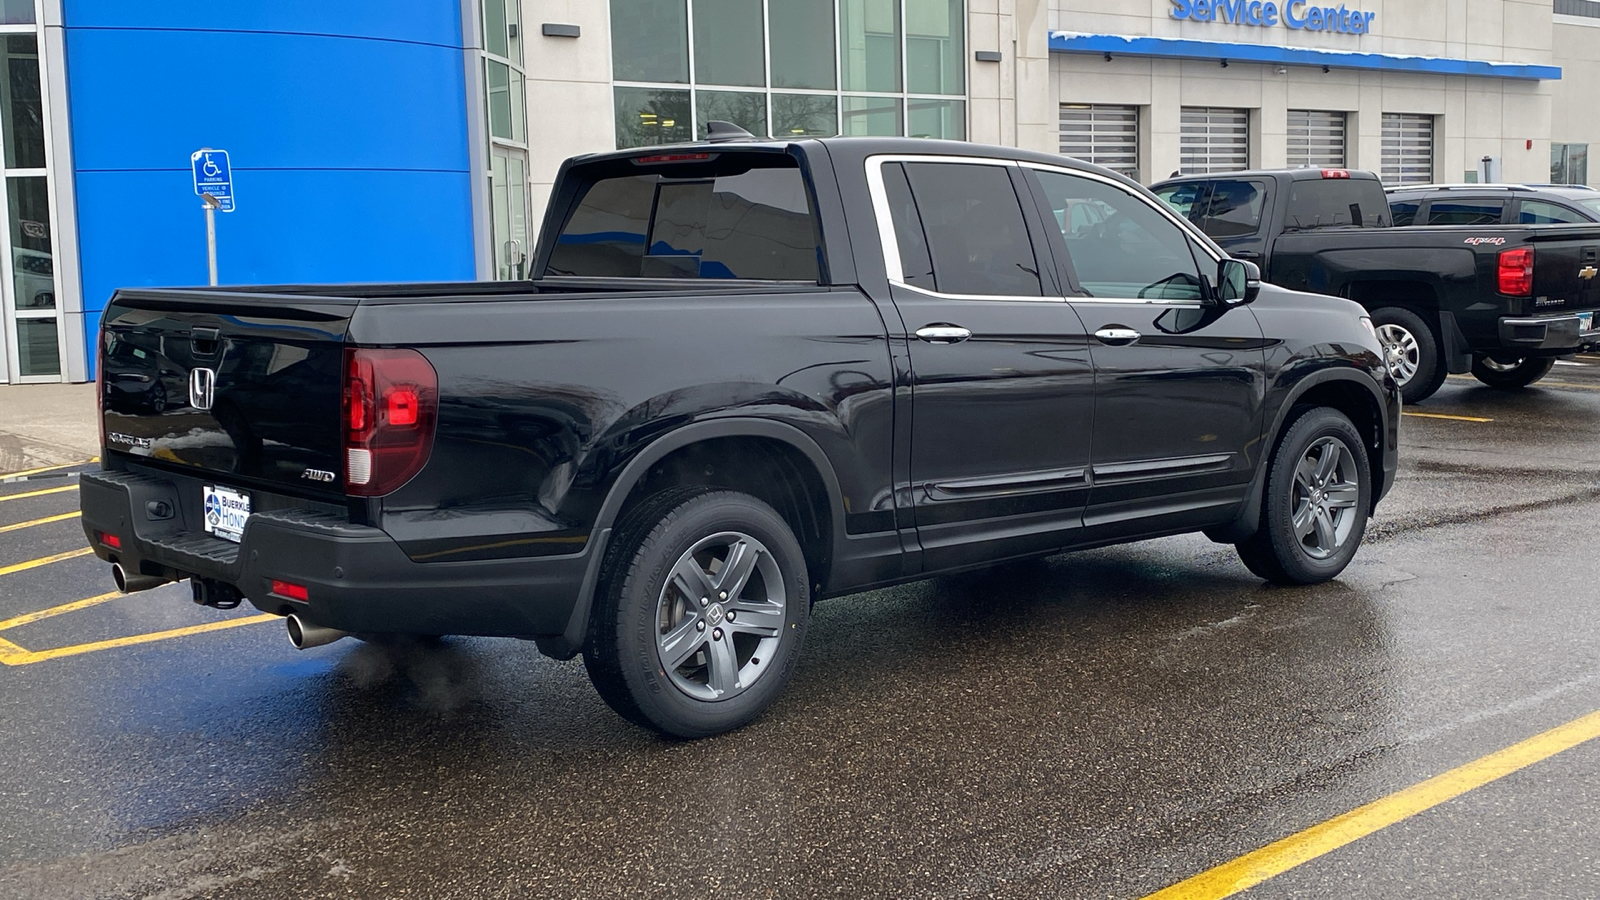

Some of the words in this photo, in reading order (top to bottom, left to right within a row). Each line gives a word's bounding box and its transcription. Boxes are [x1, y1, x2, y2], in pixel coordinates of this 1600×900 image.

[1169, 0, 1278, 27] Service
[1282, 0, 1375, 34] Center
[301, 468, 335, 482] AWD
